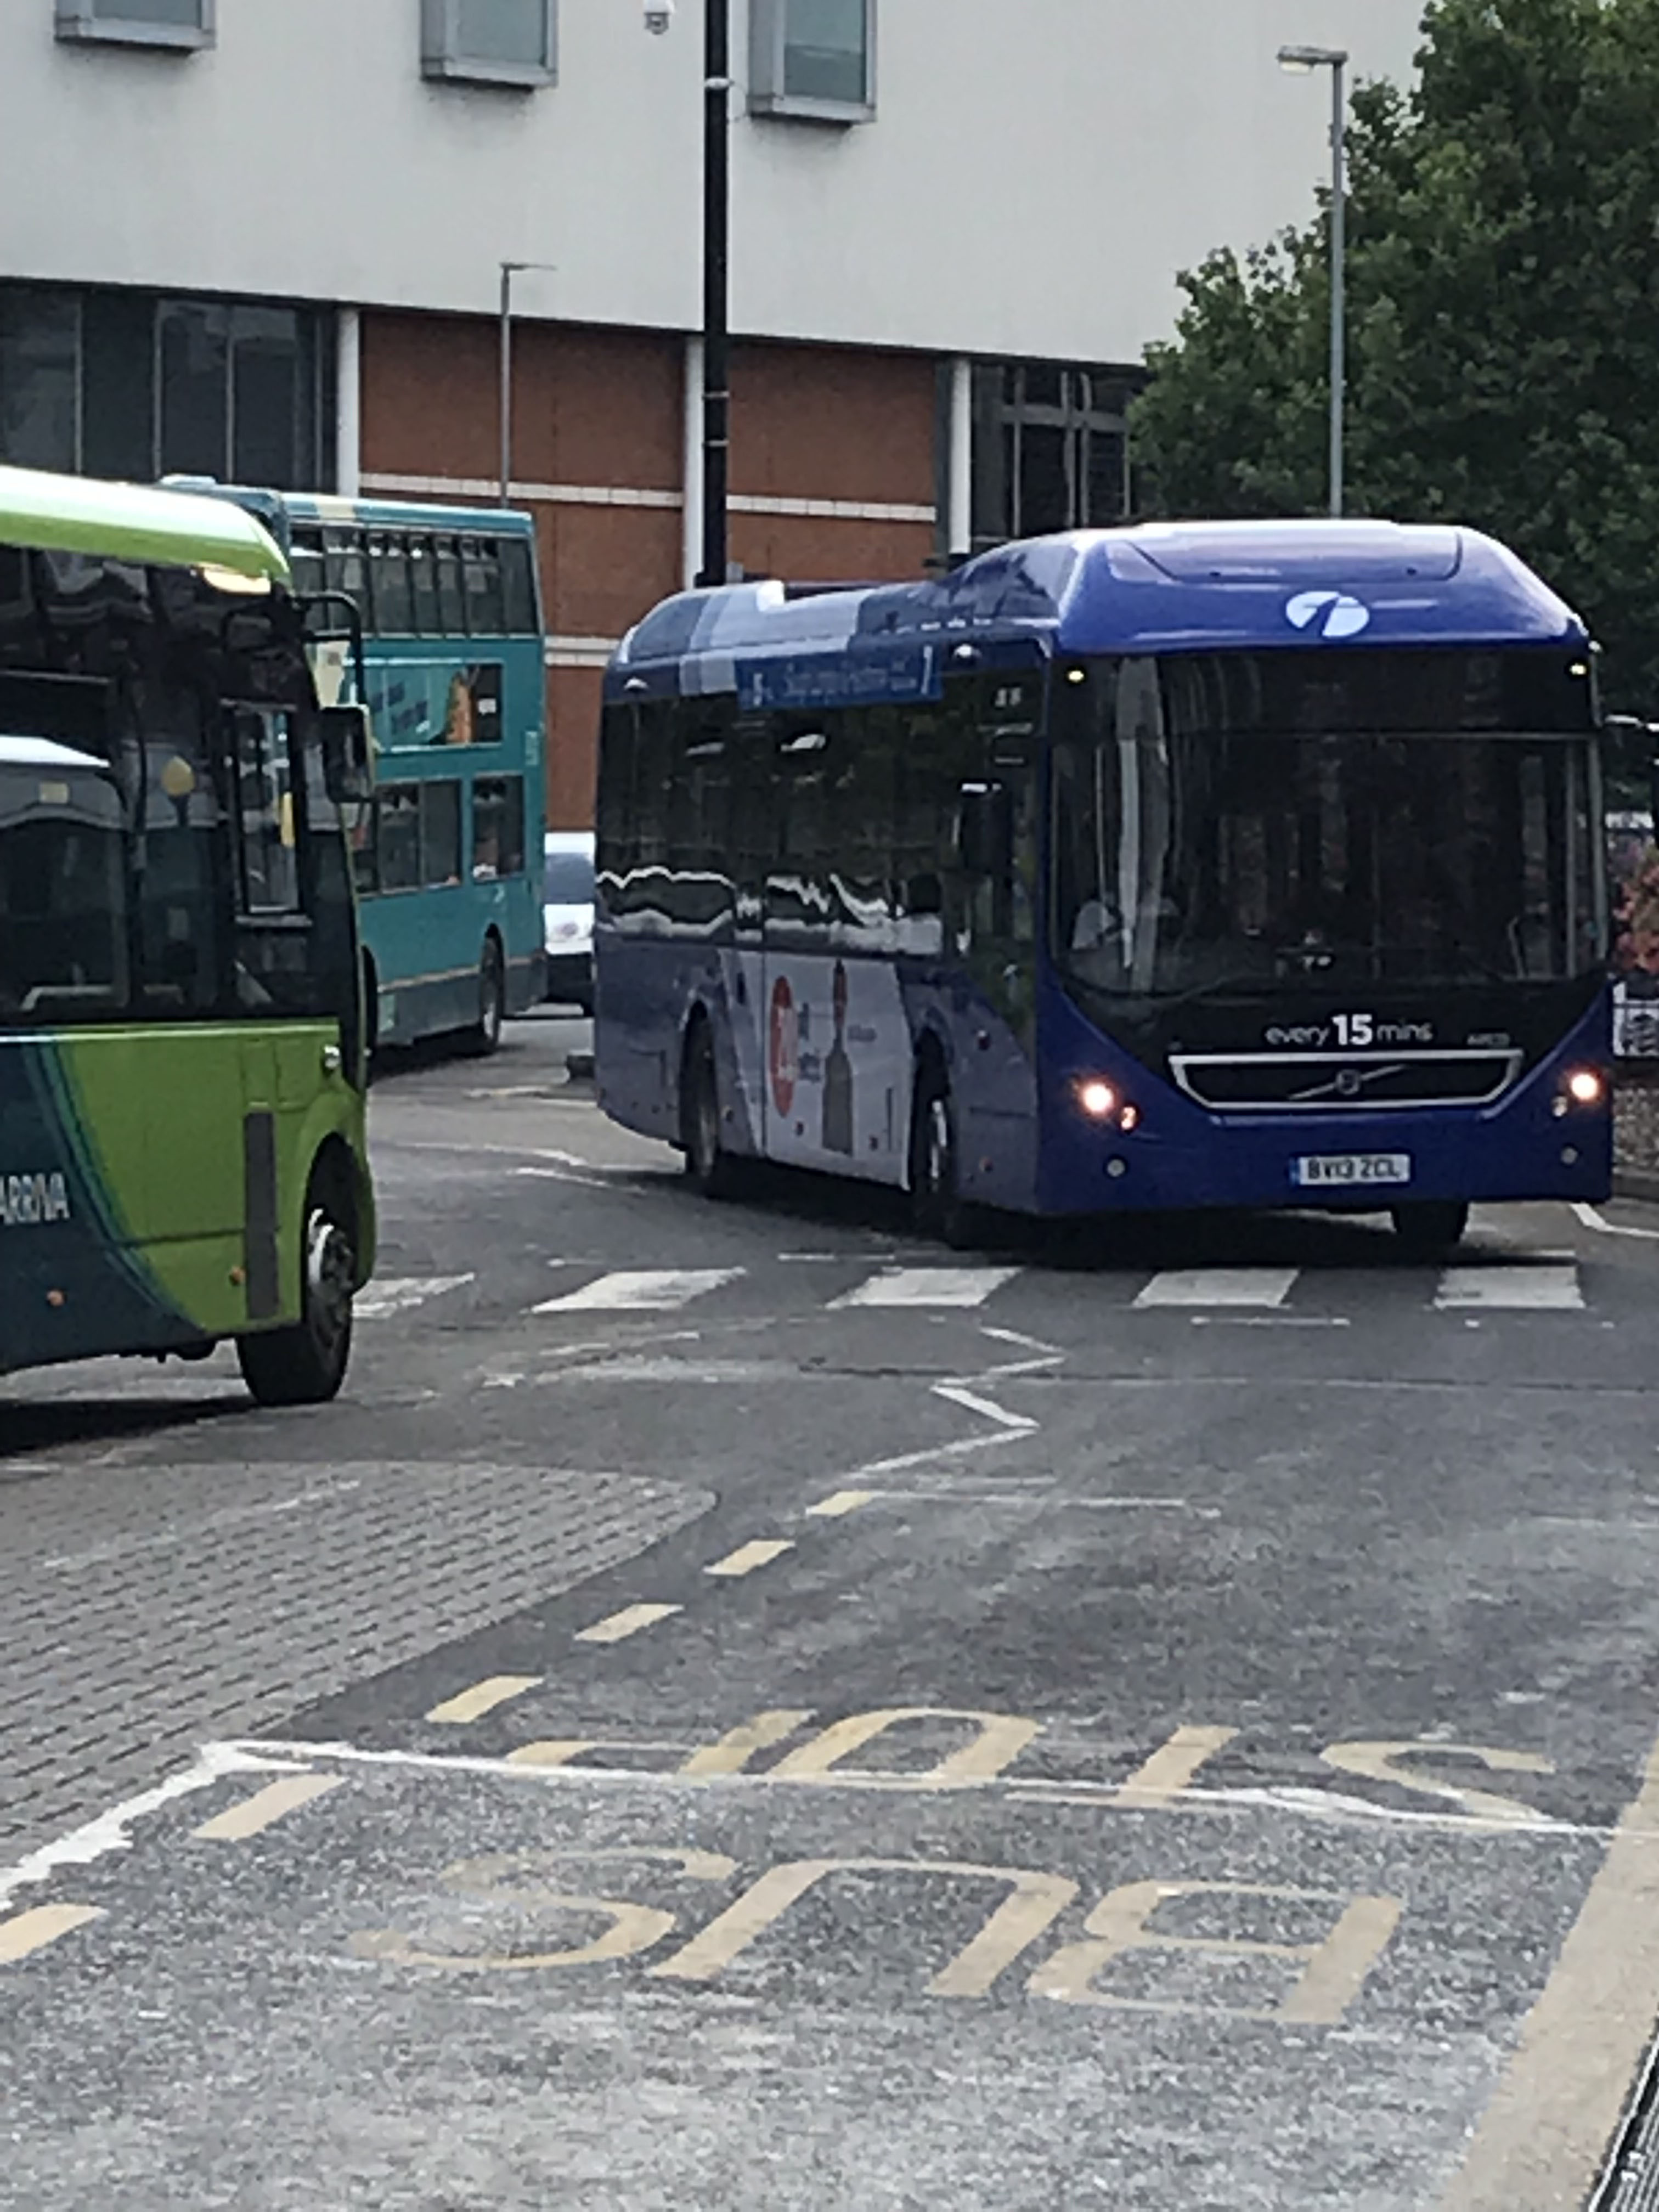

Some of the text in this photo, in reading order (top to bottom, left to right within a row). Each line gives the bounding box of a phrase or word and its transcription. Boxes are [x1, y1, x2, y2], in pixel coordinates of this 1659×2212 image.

[1265, 1013, 1433, 1046] every 15 mins
[345, 1844, 1401, 2024] BUS
